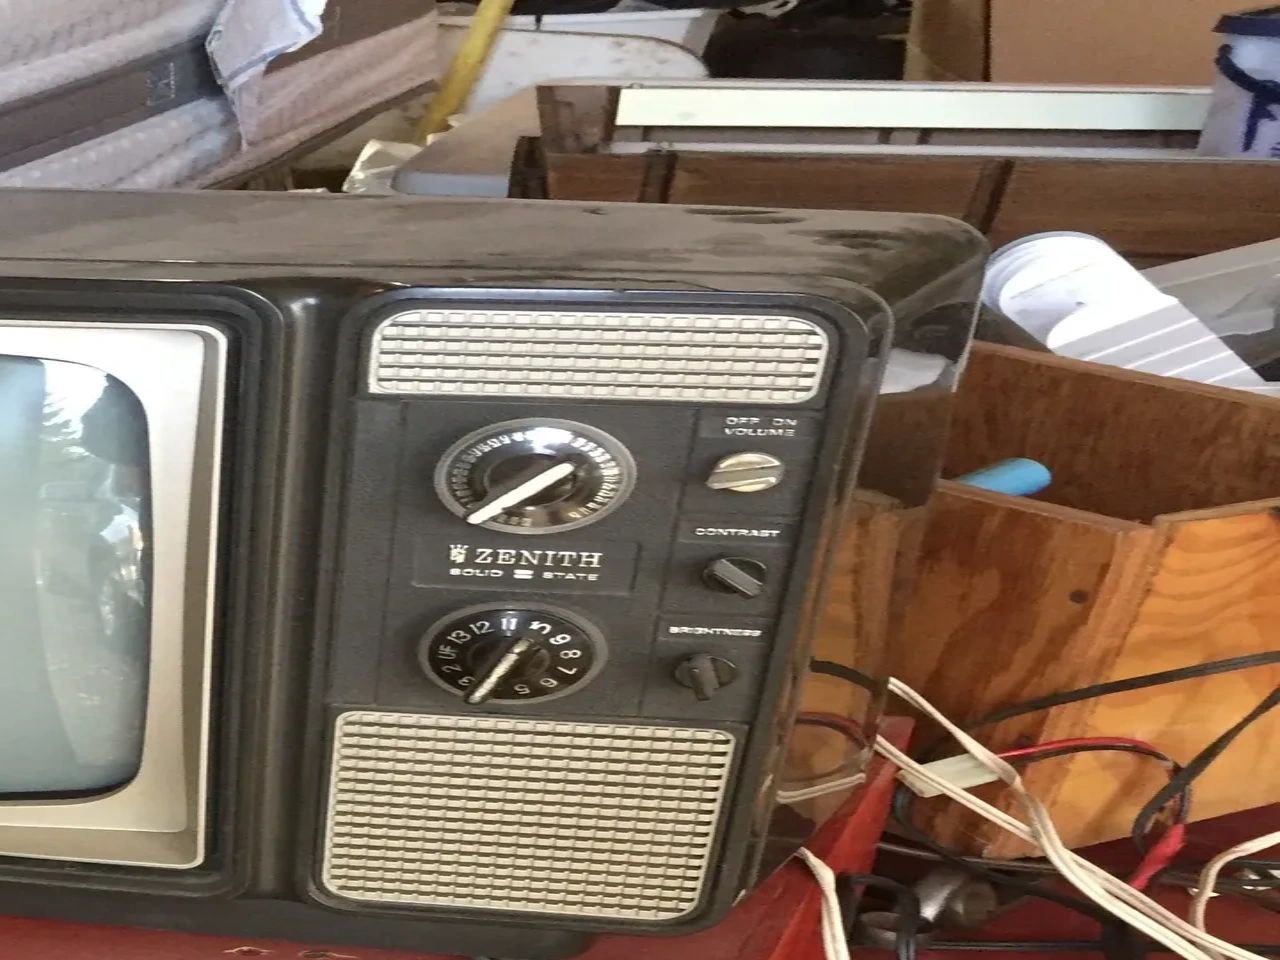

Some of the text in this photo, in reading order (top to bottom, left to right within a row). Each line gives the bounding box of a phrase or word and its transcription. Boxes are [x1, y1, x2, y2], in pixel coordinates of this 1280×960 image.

[725, 416, 798, 426] OFF ON
[724, 427, 796, 437] VOLUME
[694, 527, 781, 538] CONTRAST
[474, 548, 604, 568] ZENITH
[449, 567, 600, 581] SOLID STATE
[469, 620, 495, 635] 12
[500, 617, 518, 631] 11
[446, 630, 471, 644] 13
[668, 626, 763, 637] BRIGHTNESS
[559, 649, 582, 659] 8
[441, 663, 462, 673] 2
[556, 665, 578, 675] 7
[457, 676, 476, 686] 3
[513, 683, 531, 695] 5
